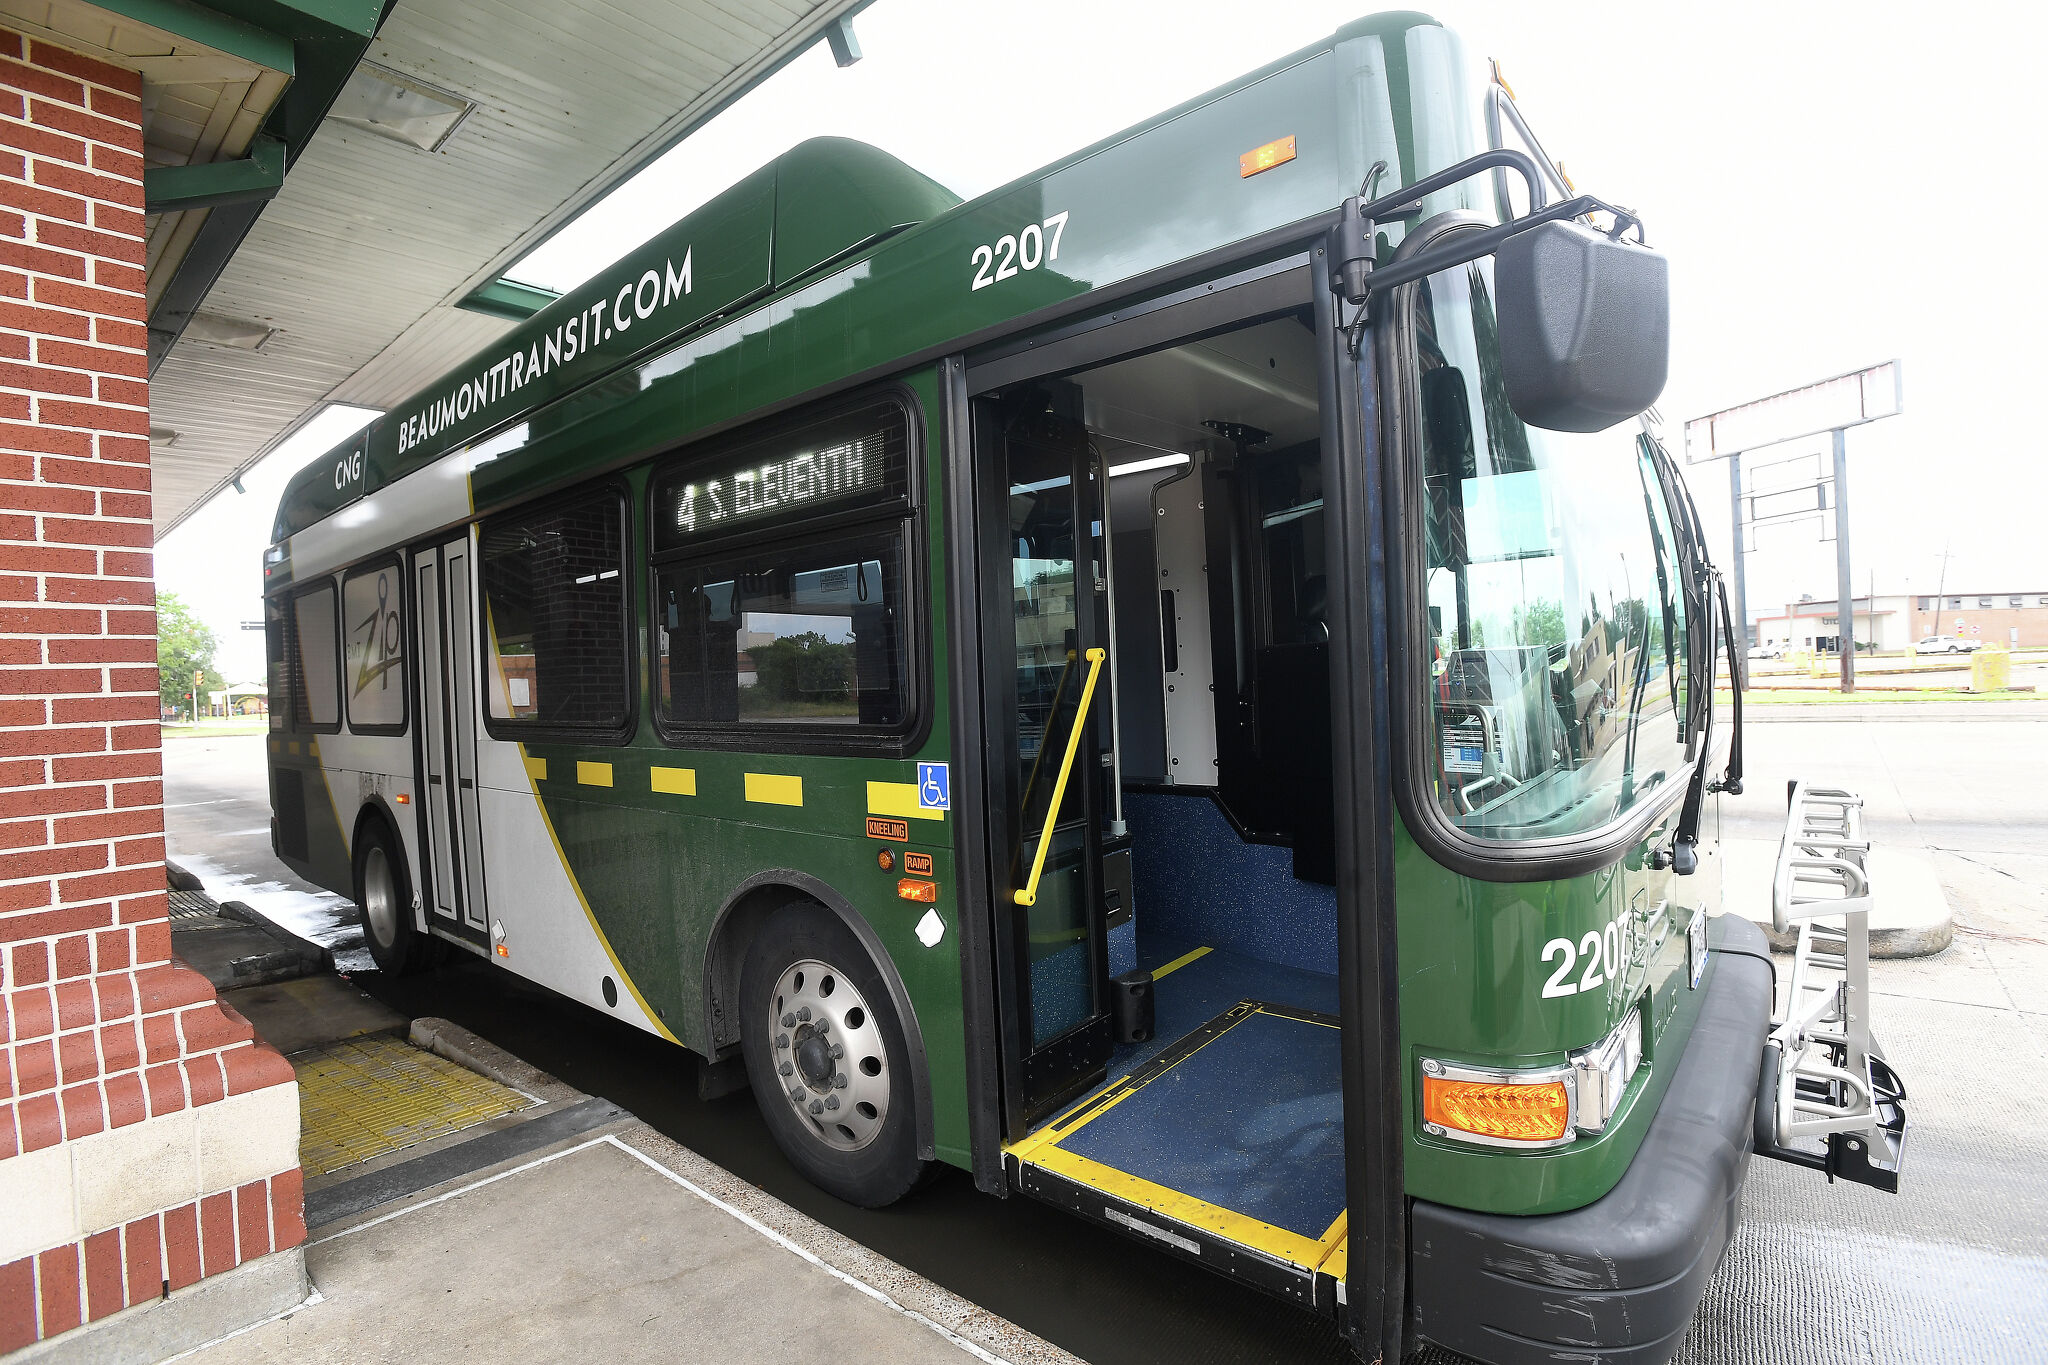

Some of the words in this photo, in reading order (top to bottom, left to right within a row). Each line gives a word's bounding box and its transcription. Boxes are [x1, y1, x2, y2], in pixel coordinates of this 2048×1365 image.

[970, 209, 1069, 292] 2207
[398, 244, 693, 455] BEAUMONTTRANSIT.COM
[335, 450, 362, 490] CNG
[677, 484, 696, 532] 4
[734, 441, 864, 515] ELEVENTH
[869, 821, 905, 838] KNEELING
[907, 856, 930, 870] RAMP
[1541, 910, 1628, 999] 2207
